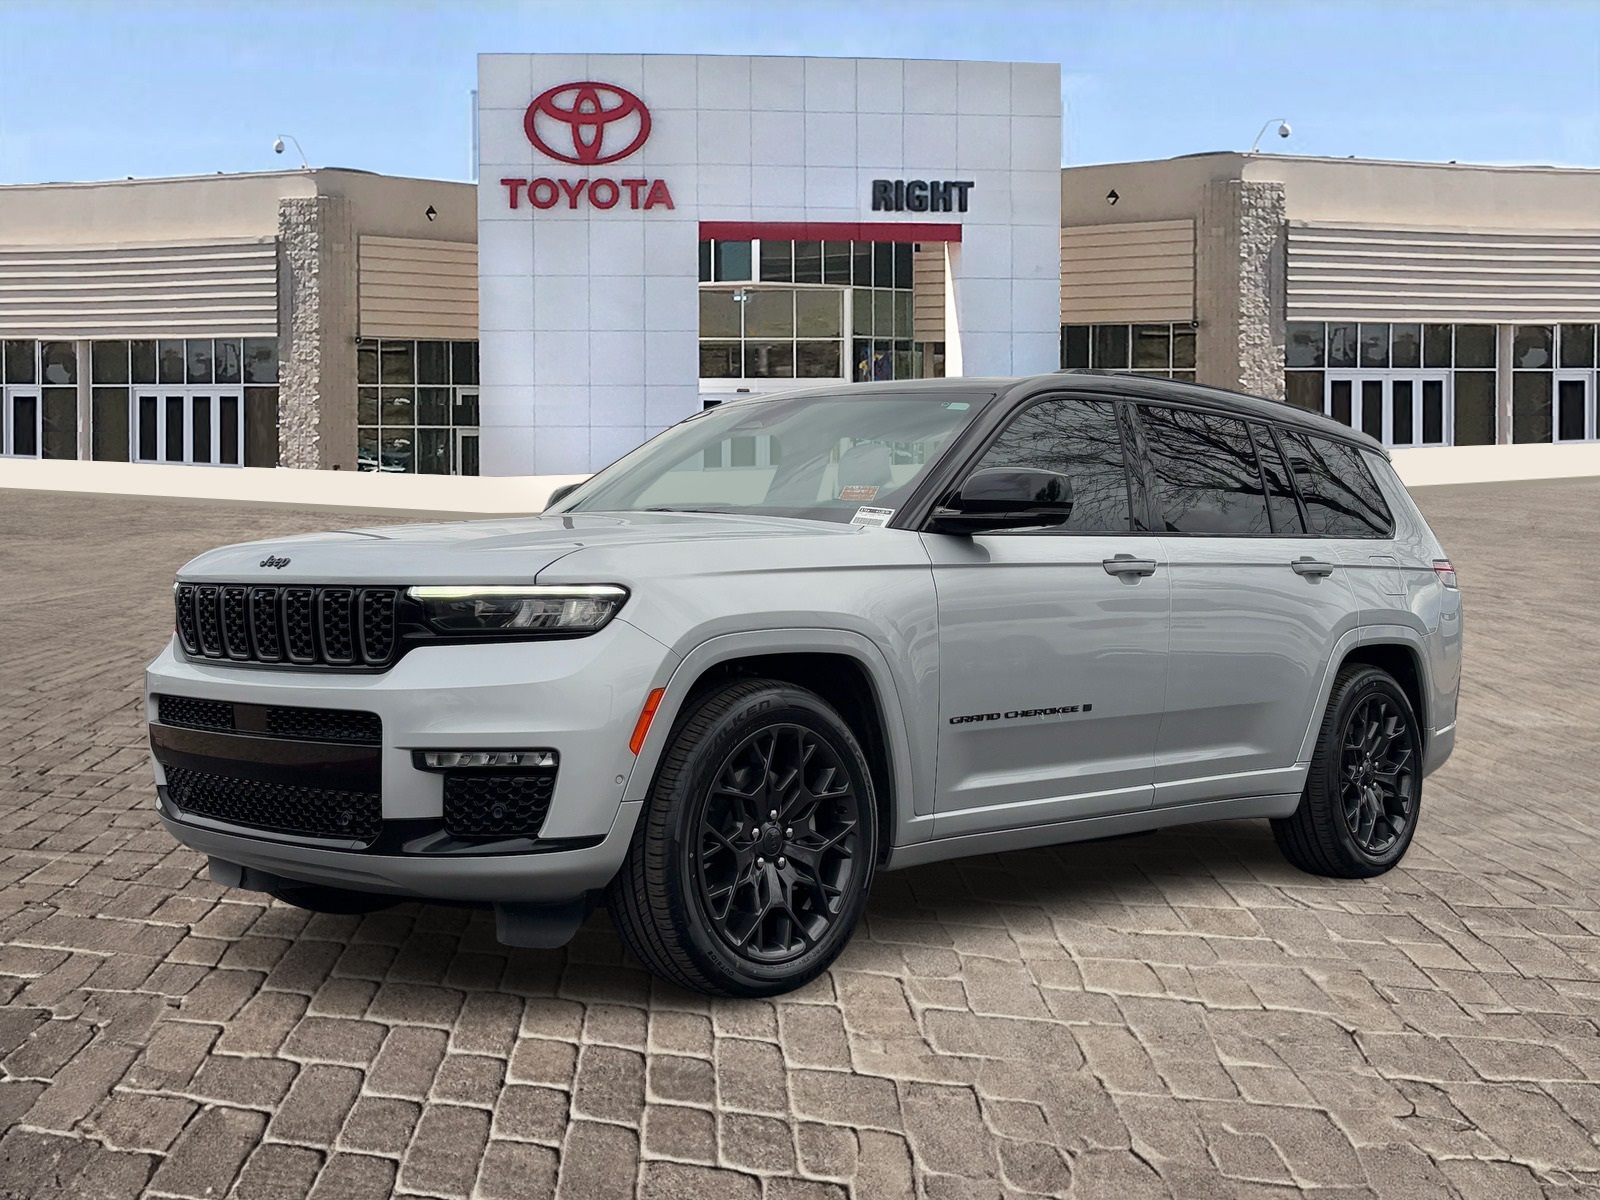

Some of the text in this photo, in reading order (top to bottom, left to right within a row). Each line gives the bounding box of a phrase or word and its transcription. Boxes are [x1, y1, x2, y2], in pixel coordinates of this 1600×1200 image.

[500, 178, 675, 211] TOYOTA
[871, 179, 975, 213] RIGHT
[259, 555, 291, 570] Jeep
[949, 712, 1001, 725] GRAND
[1004, 704, 1080, 719] CHEROKEE
